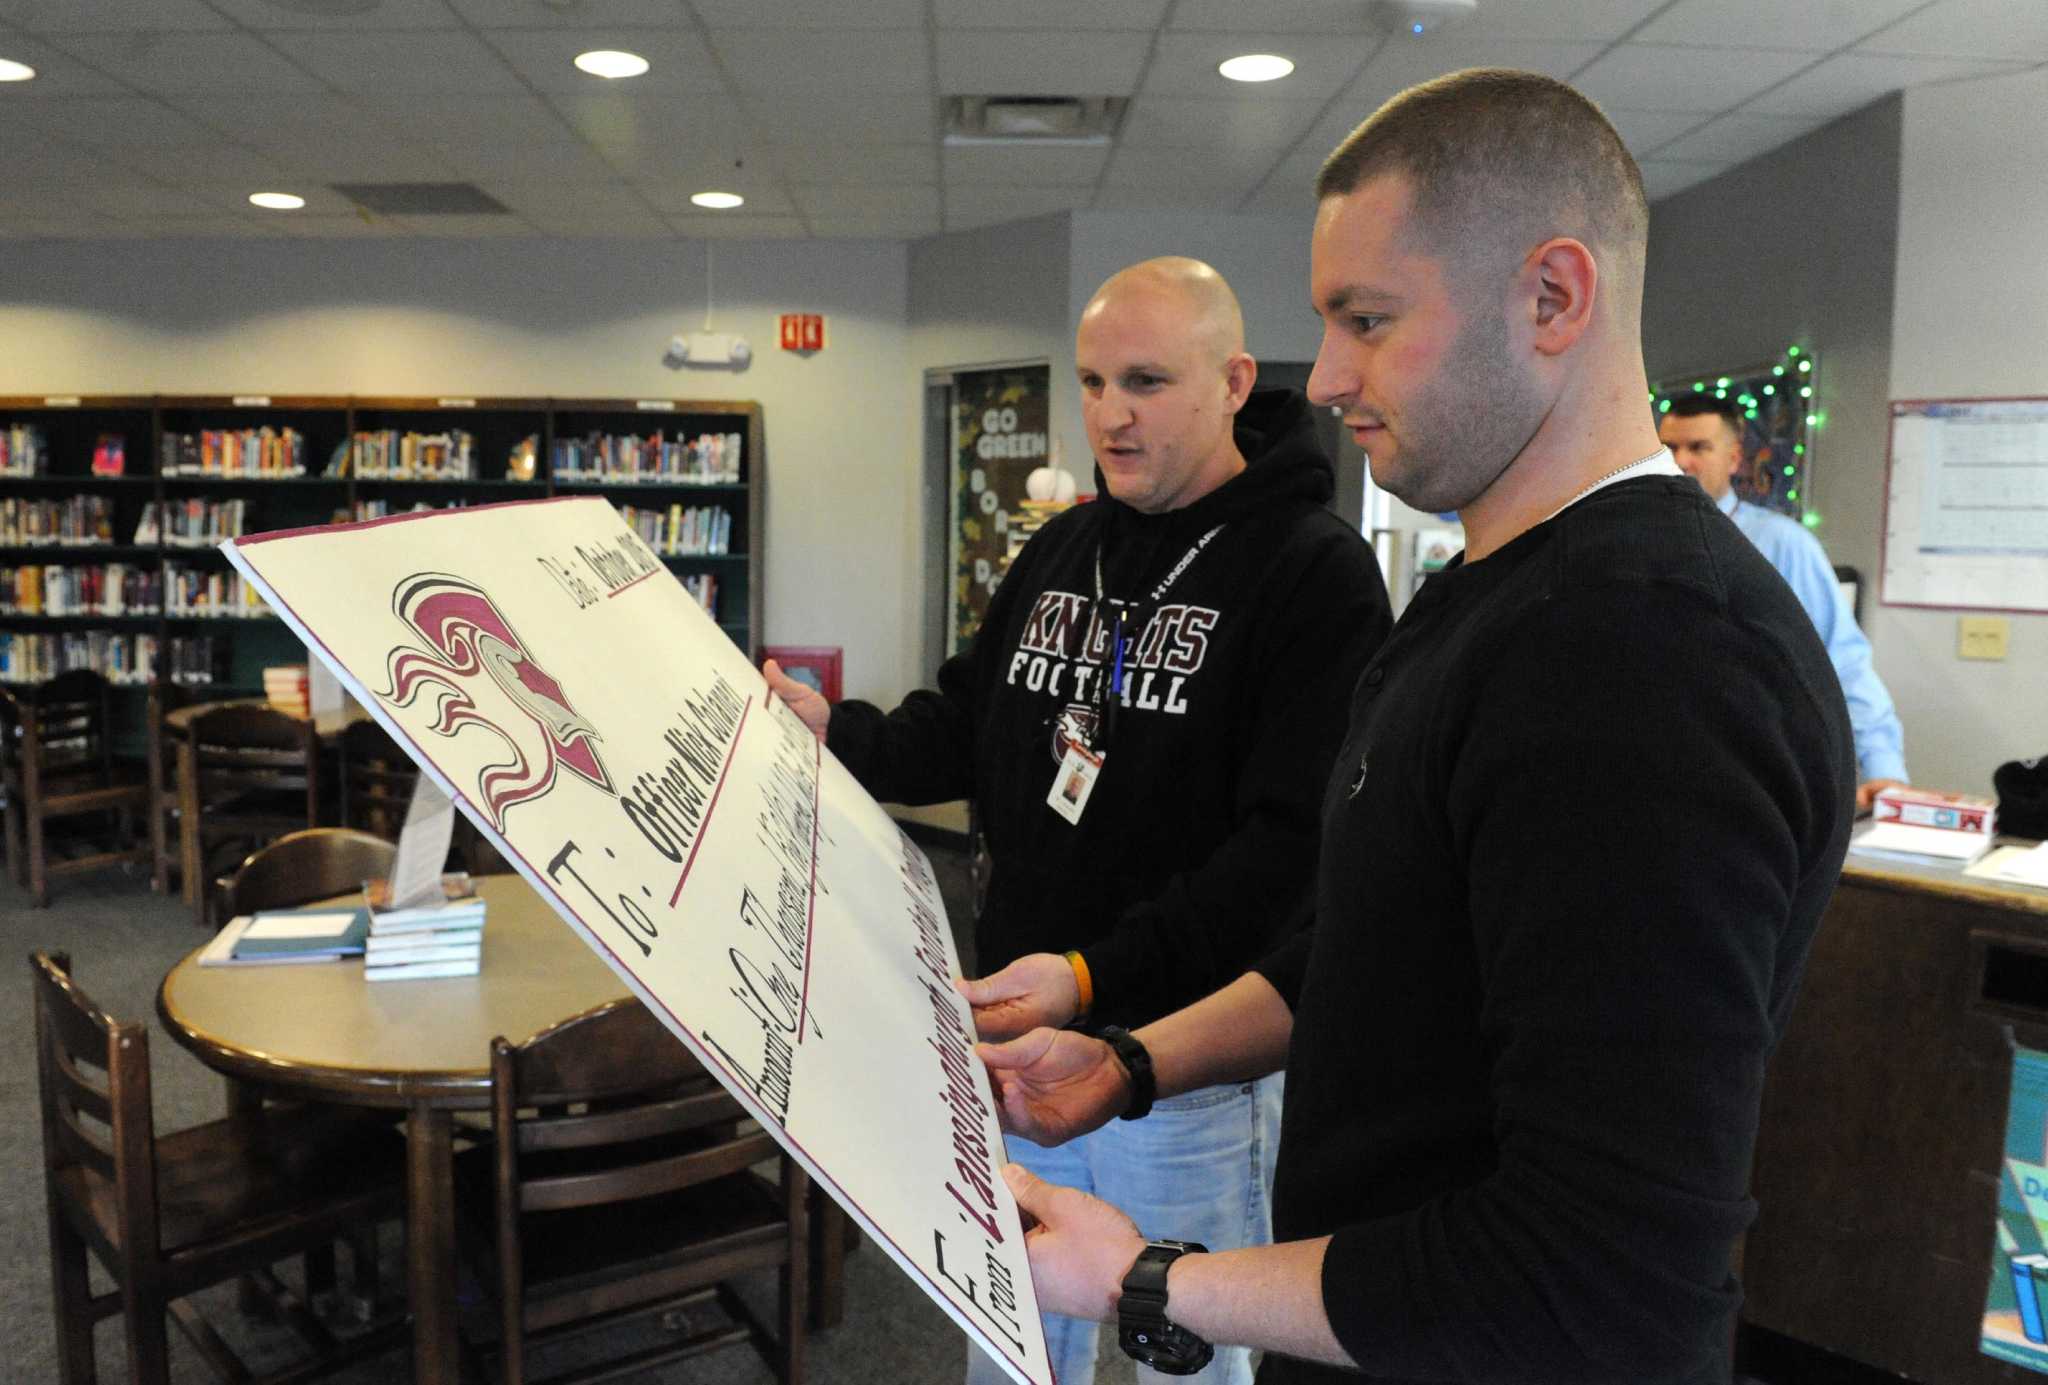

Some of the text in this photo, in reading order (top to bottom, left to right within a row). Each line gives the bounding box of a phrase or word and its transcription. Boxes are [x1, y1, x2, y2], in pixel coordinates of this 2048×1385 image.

[976, 432, 1047, 459] GREEN
[982, 408, 1018, 433] GO
[1163, 547, 1199, 586] UNDER
[546, 840, 658, 957] To:
[620, 757, 708, 863] Officer
[664, 712, 724, 785] Nick
[729, 947, 824, 1040] One
[702, 986, 794, 1129] Amount:
[934, 1211, 1026, 1356] From:
